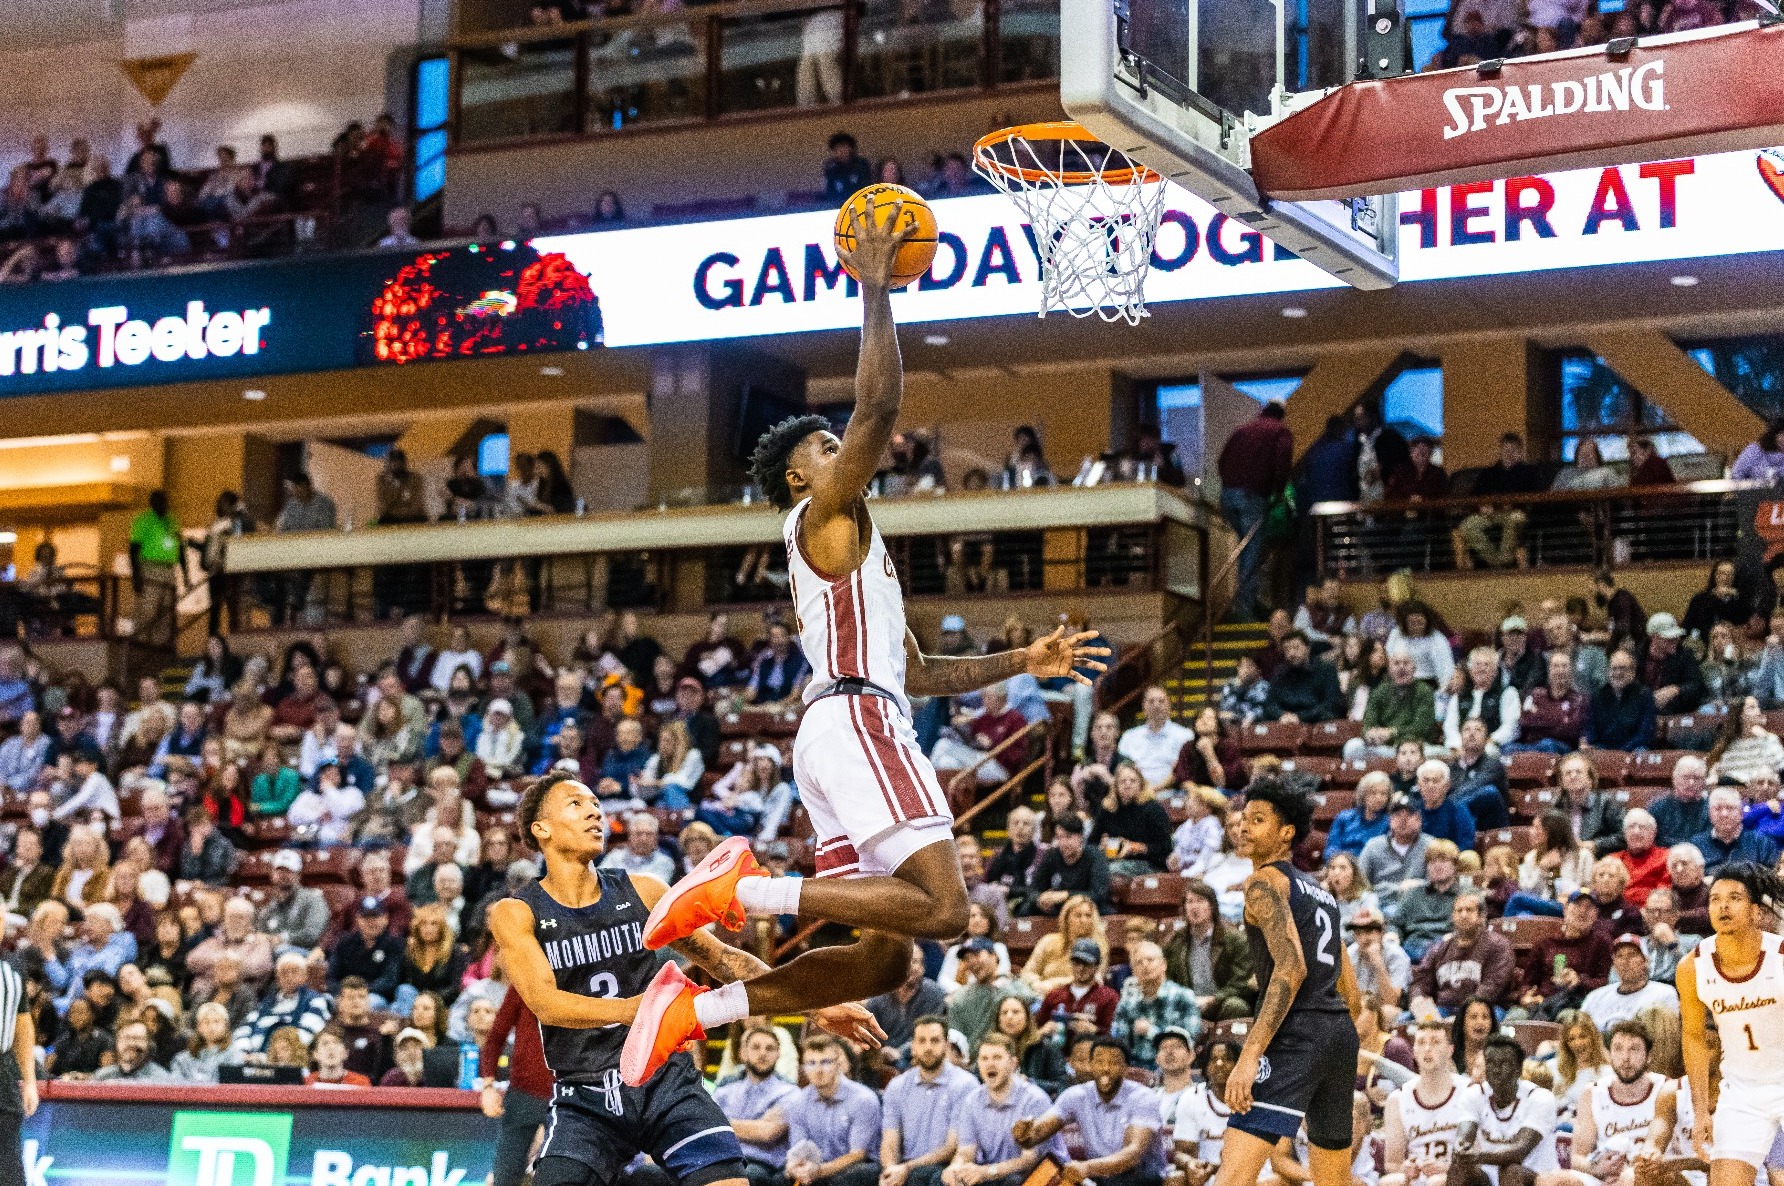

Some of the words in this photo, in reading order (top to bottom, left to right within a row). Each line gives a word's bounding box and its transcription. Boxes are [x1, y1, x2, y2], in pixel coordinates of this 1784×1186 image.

[1443, 60, 1664, 139] SPALDING
[693, 221, 1067, 310] GAMDAY
[1089, 175, 1558, 274] TOGHER
[1582, 159, 1695, 235] AT
[88, 300, 271, 367] Teeter
[616, 902, 631, 911] CAA
[545, 921, 643, 970] MONMOUTH
[1315, 906, 1335, 966] 2
[1712, 995, 1777, 1014] Charleston
[1743, 1024, 1759, 1051] 1
[182, 1136, 275, 1186] TD
[311, 1149, 468, 1186] Bank
